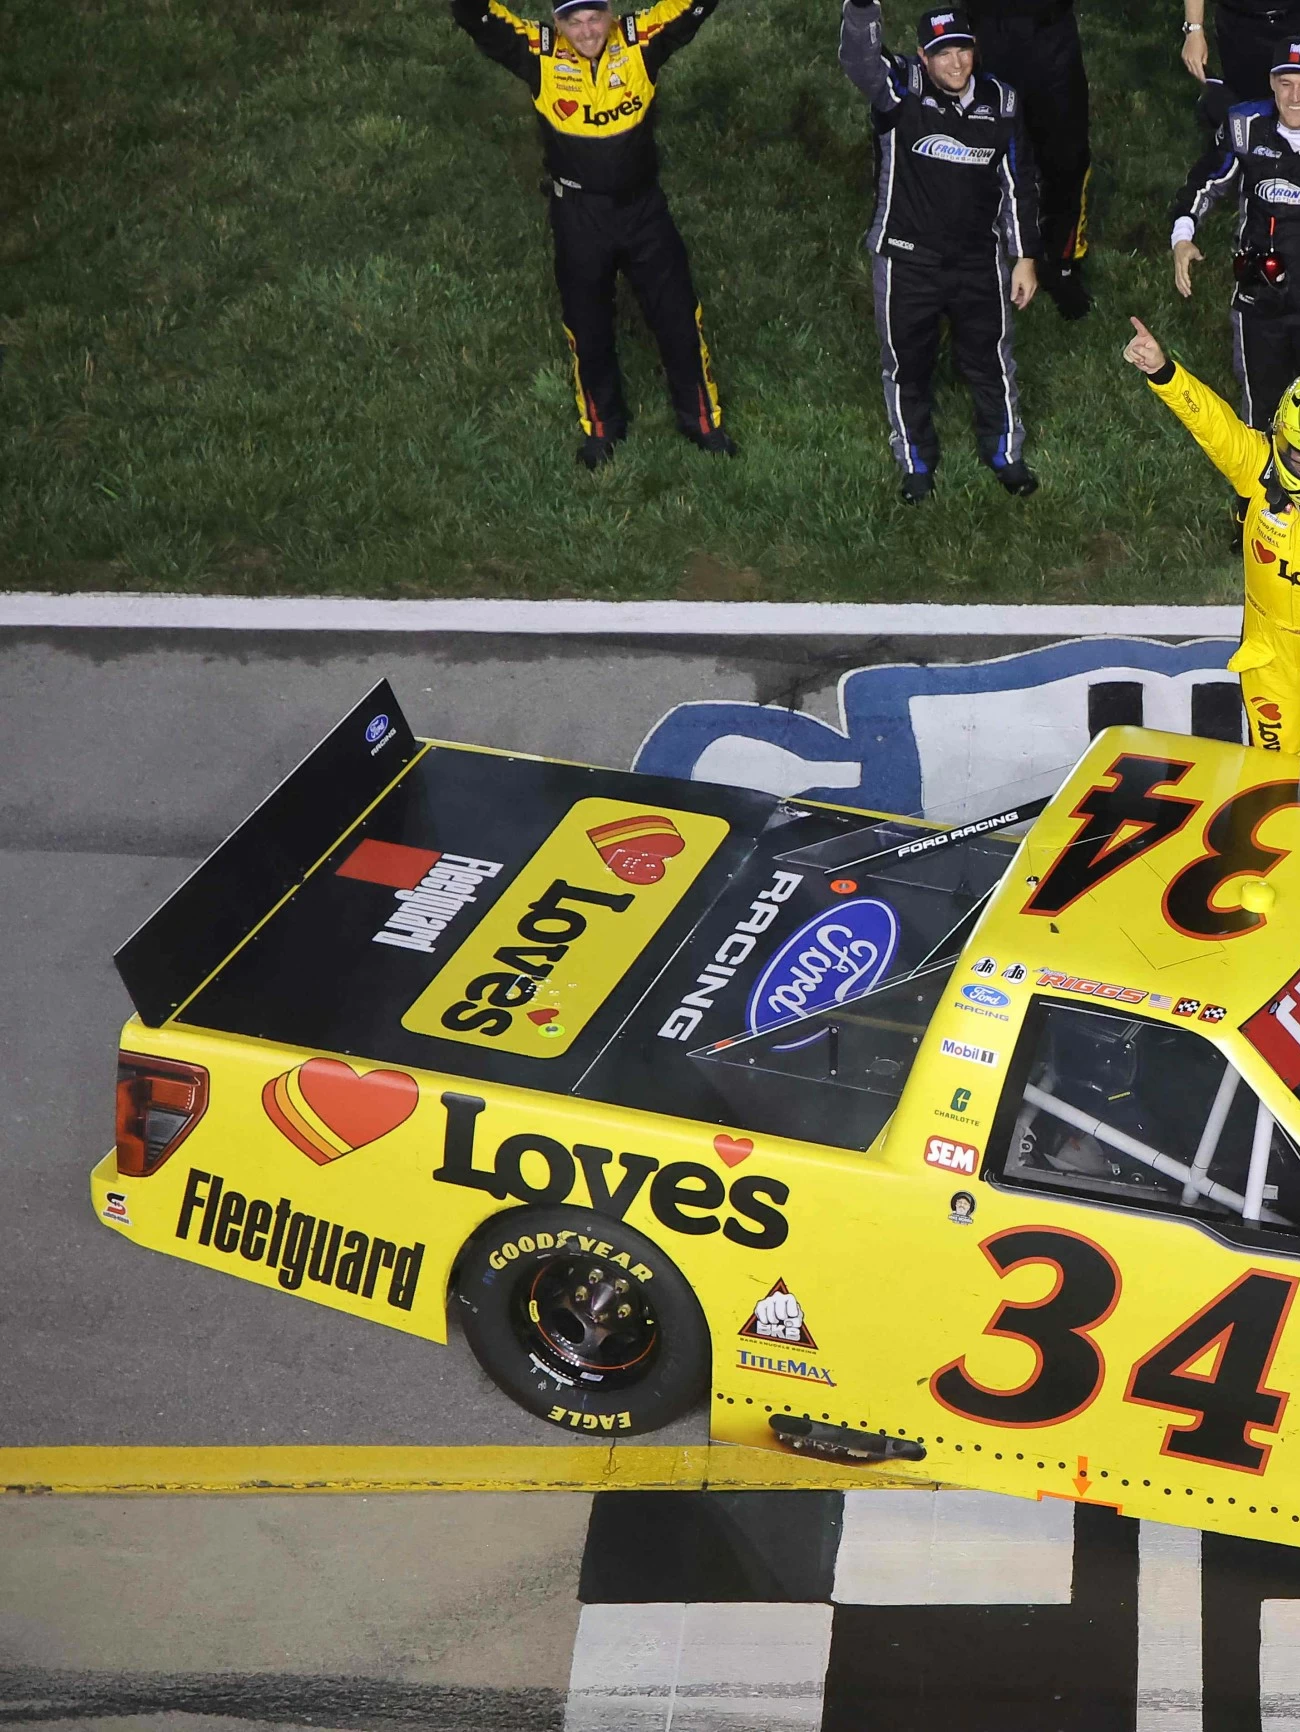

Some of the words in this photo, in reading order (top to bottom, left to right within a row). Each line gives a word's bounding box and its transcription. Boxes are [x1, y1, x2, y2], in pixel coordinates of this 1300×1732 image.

[368, 716, 387, 740] Ford
[370, 728, 396, 756] RACING
[897, 834, 949, 859] FORD
[950, 811, 1019, 841] RACING
[371, 853, 504, 953] Fleetguard
[657, 870, 804, 1042] RACING
[768, 923, 878, 1019] Ford
[970, 986, 1001, 1006] Ford
[1037, 974, 1150, 1004] RIGGS
[954, 1001, 1009, 1022] RACING
[942, 1039, 979, 1061] Mobil
[980, 1049, 994, 1064] 1
[934, 1109, 979, 1127] CHARLOTTE
[927, 1139, 975, 1173] SEM
[175, 1167, 425, 1311] Fleetguard
[488, 1230, 655, 1284] GOODYEAR
[757, 1321, 801, 1341] BKB
[929, 1224, 1300, 1476] 34
[548, 1404, 631, 1430] EAGLE
